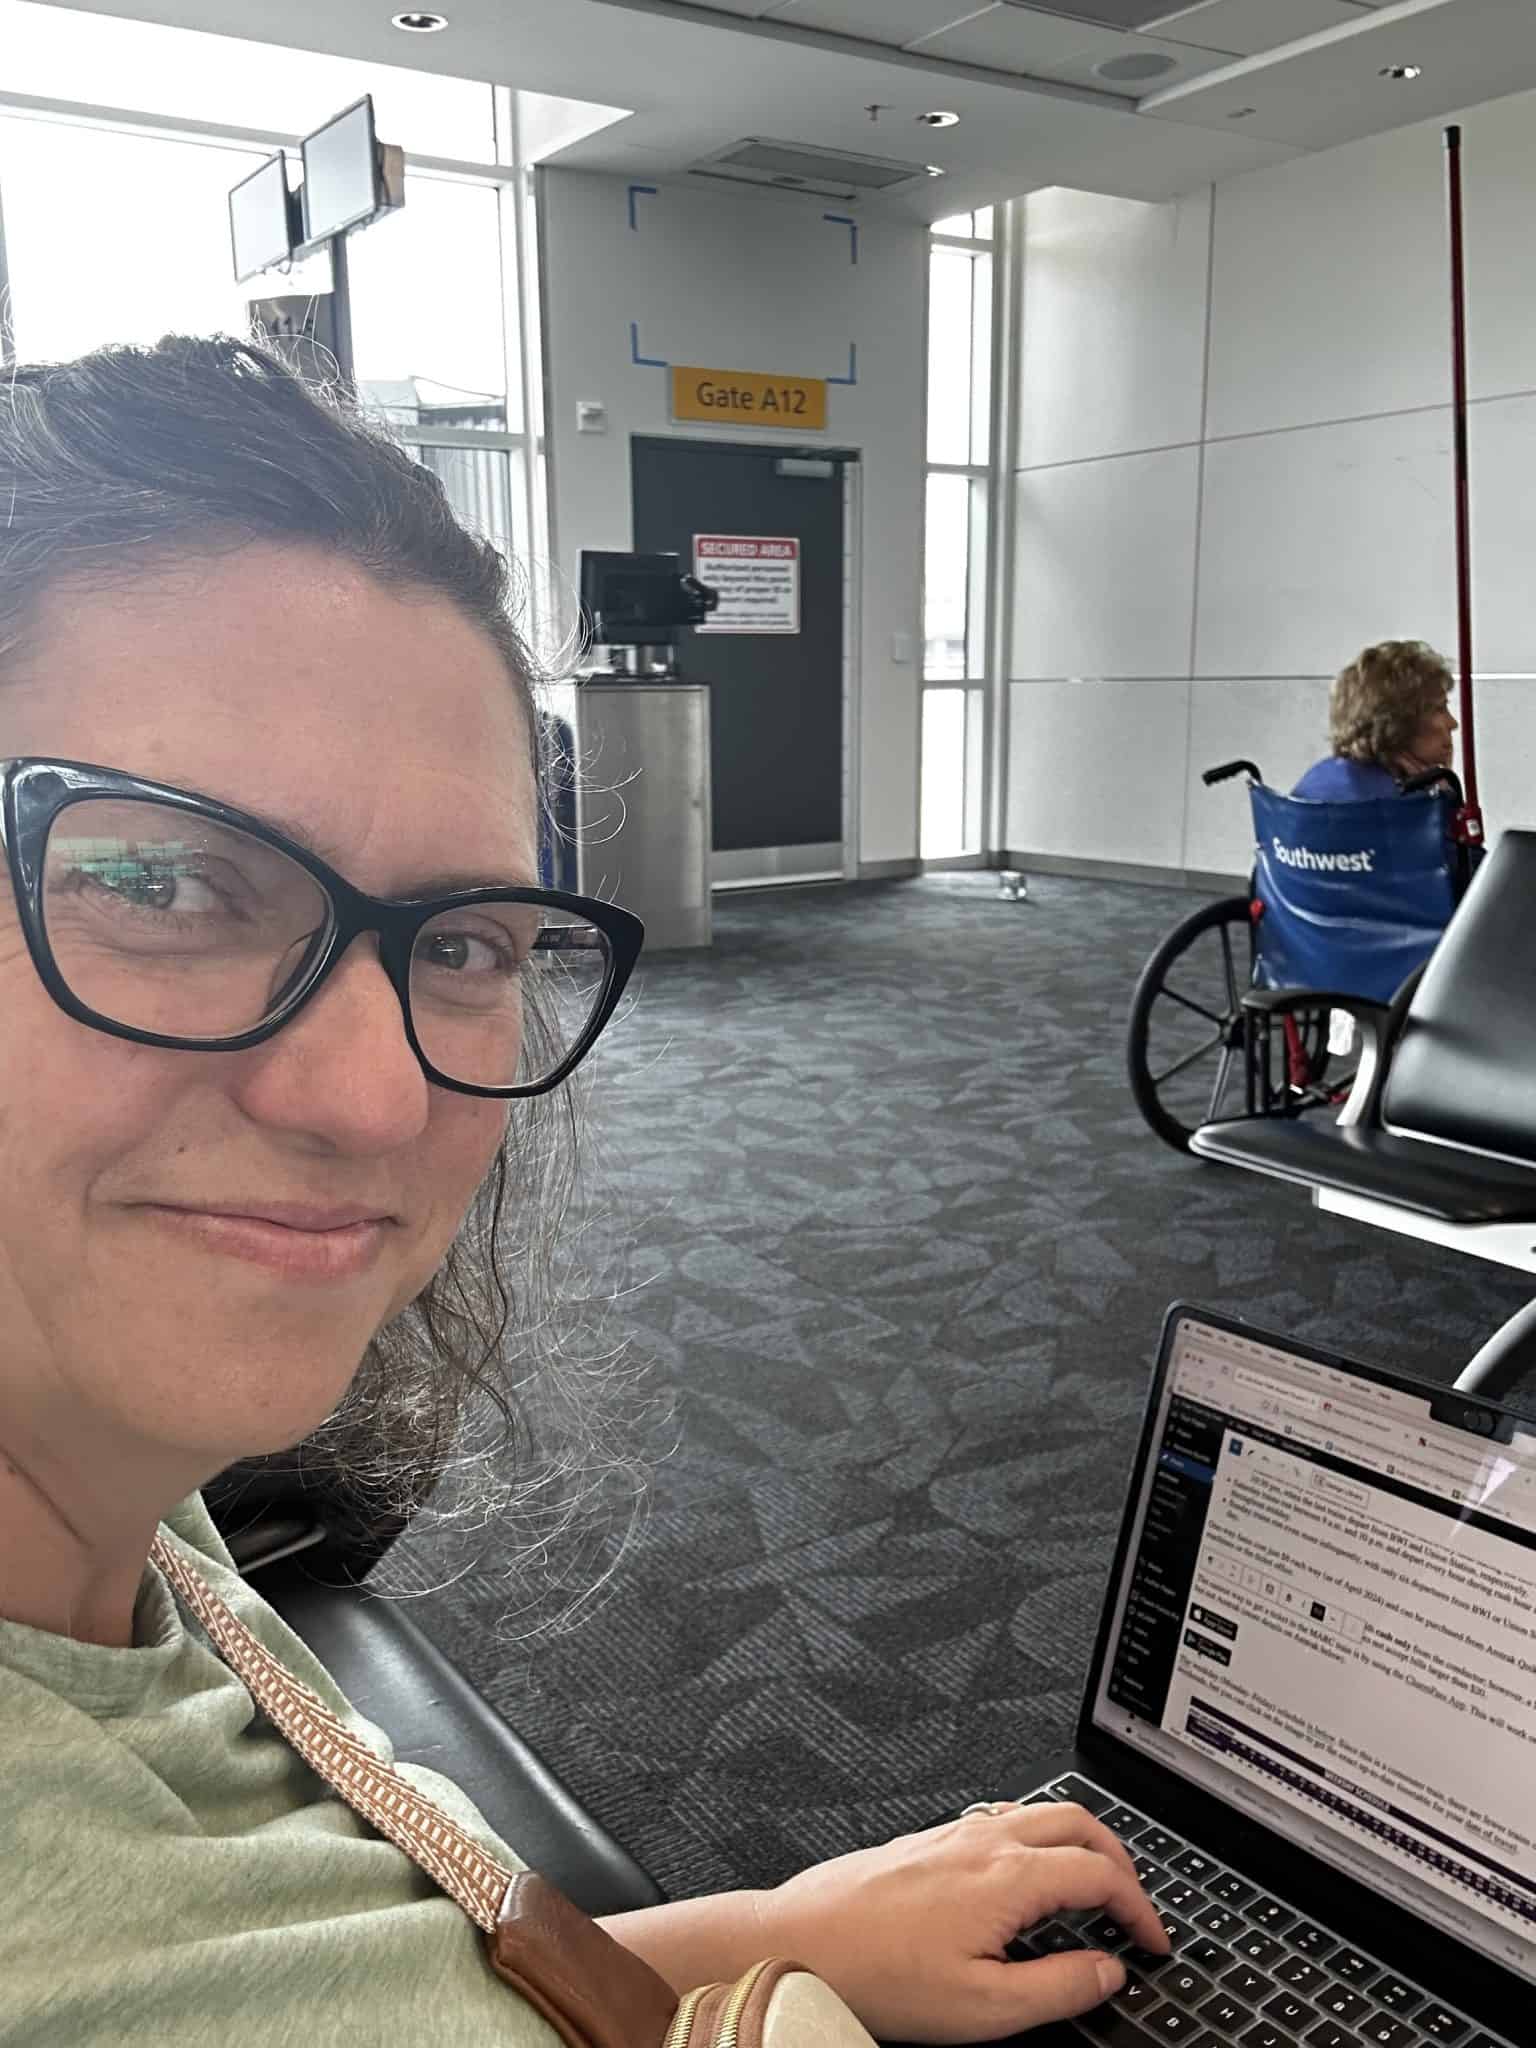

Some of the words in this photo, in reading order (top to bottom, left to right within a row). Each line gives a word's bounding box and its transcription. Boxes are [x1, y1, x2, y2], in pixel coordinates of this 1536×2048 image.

[696, 381, 753, 411] Gate
[760, 389, 808, 414] A12
[701, 542, 758, 557] SECURED
[760, 544, 793, 557] AREA
[1179, 1977, 1194, 1989] G
[1244, 1976, 1257, 1987] Y
[1128, 1985, 1142, 1997] V
[1284, 2005, 1299, 2017] U
[1263, 2036, 1277, 2046] J
